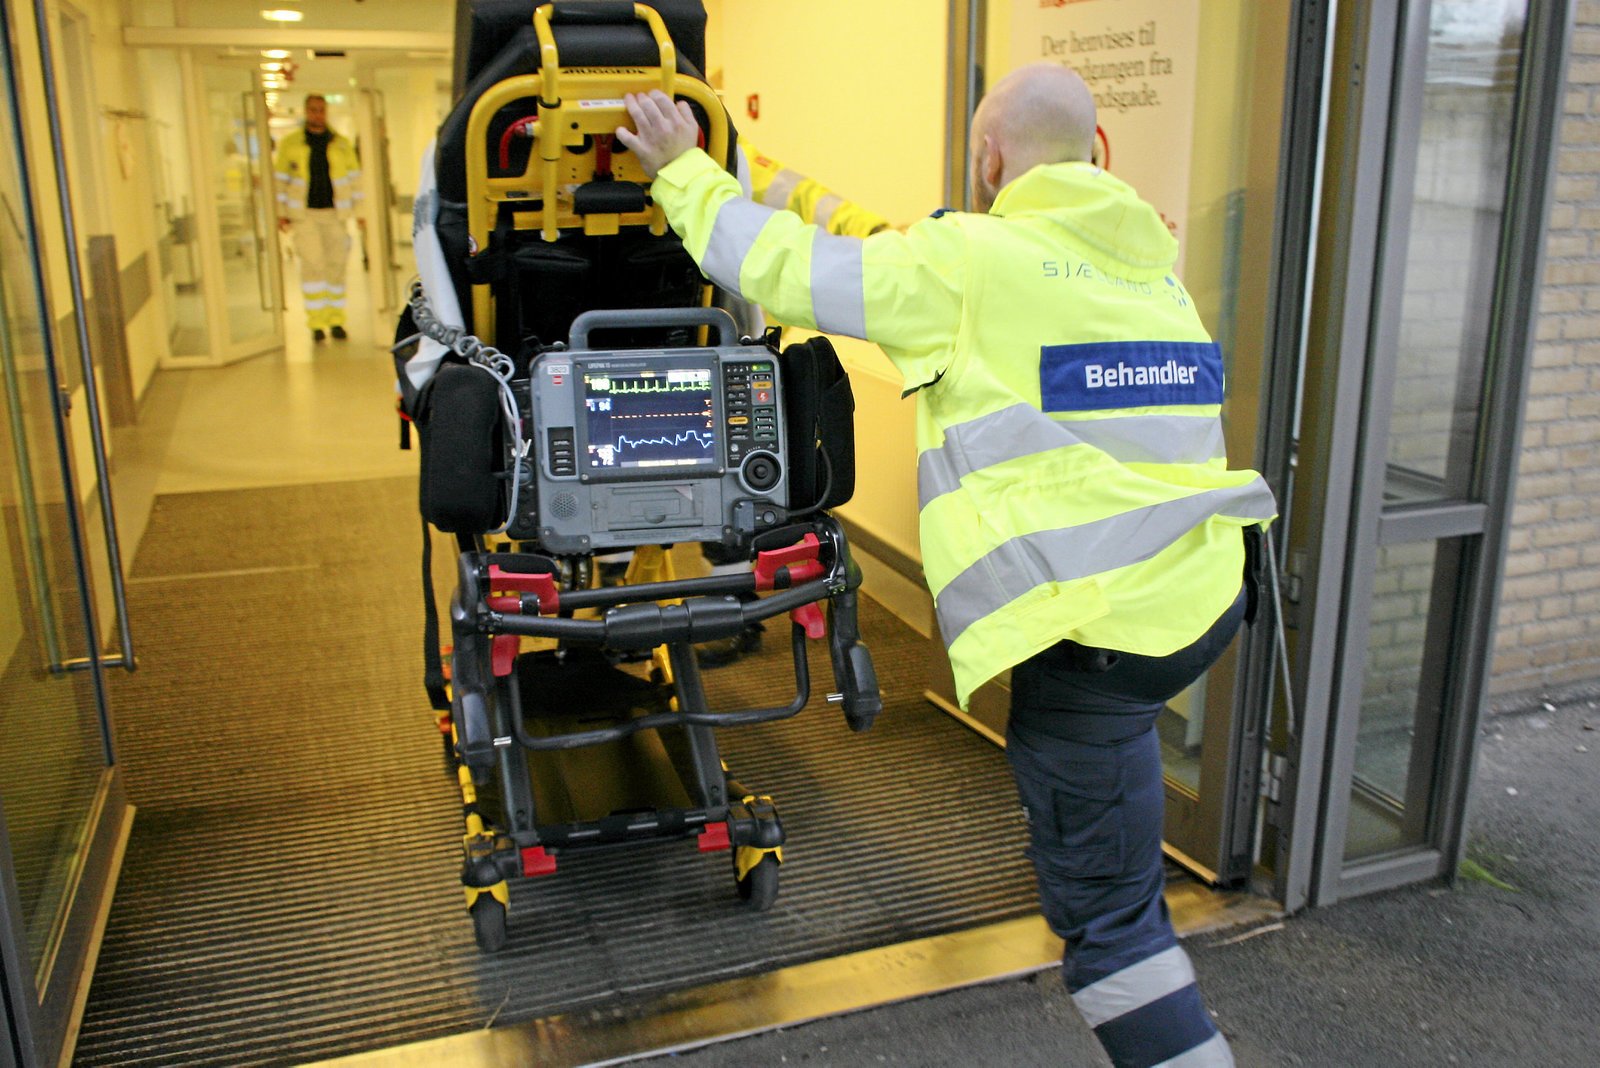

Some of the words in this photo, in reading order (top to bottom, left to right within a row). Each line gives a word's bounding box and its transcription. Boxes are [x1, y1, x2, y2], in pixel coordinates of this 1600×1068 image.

[1041, 35, 1067, 56] Der
[1069, 29, 1134, 53] henvises
[1138, 20, 1155, 46] til
[1149, 51, 1173, 76] fra
[1092, 82, 1161, 114] ndsgade.
[1085, 360, 1198, 388] Behandler
